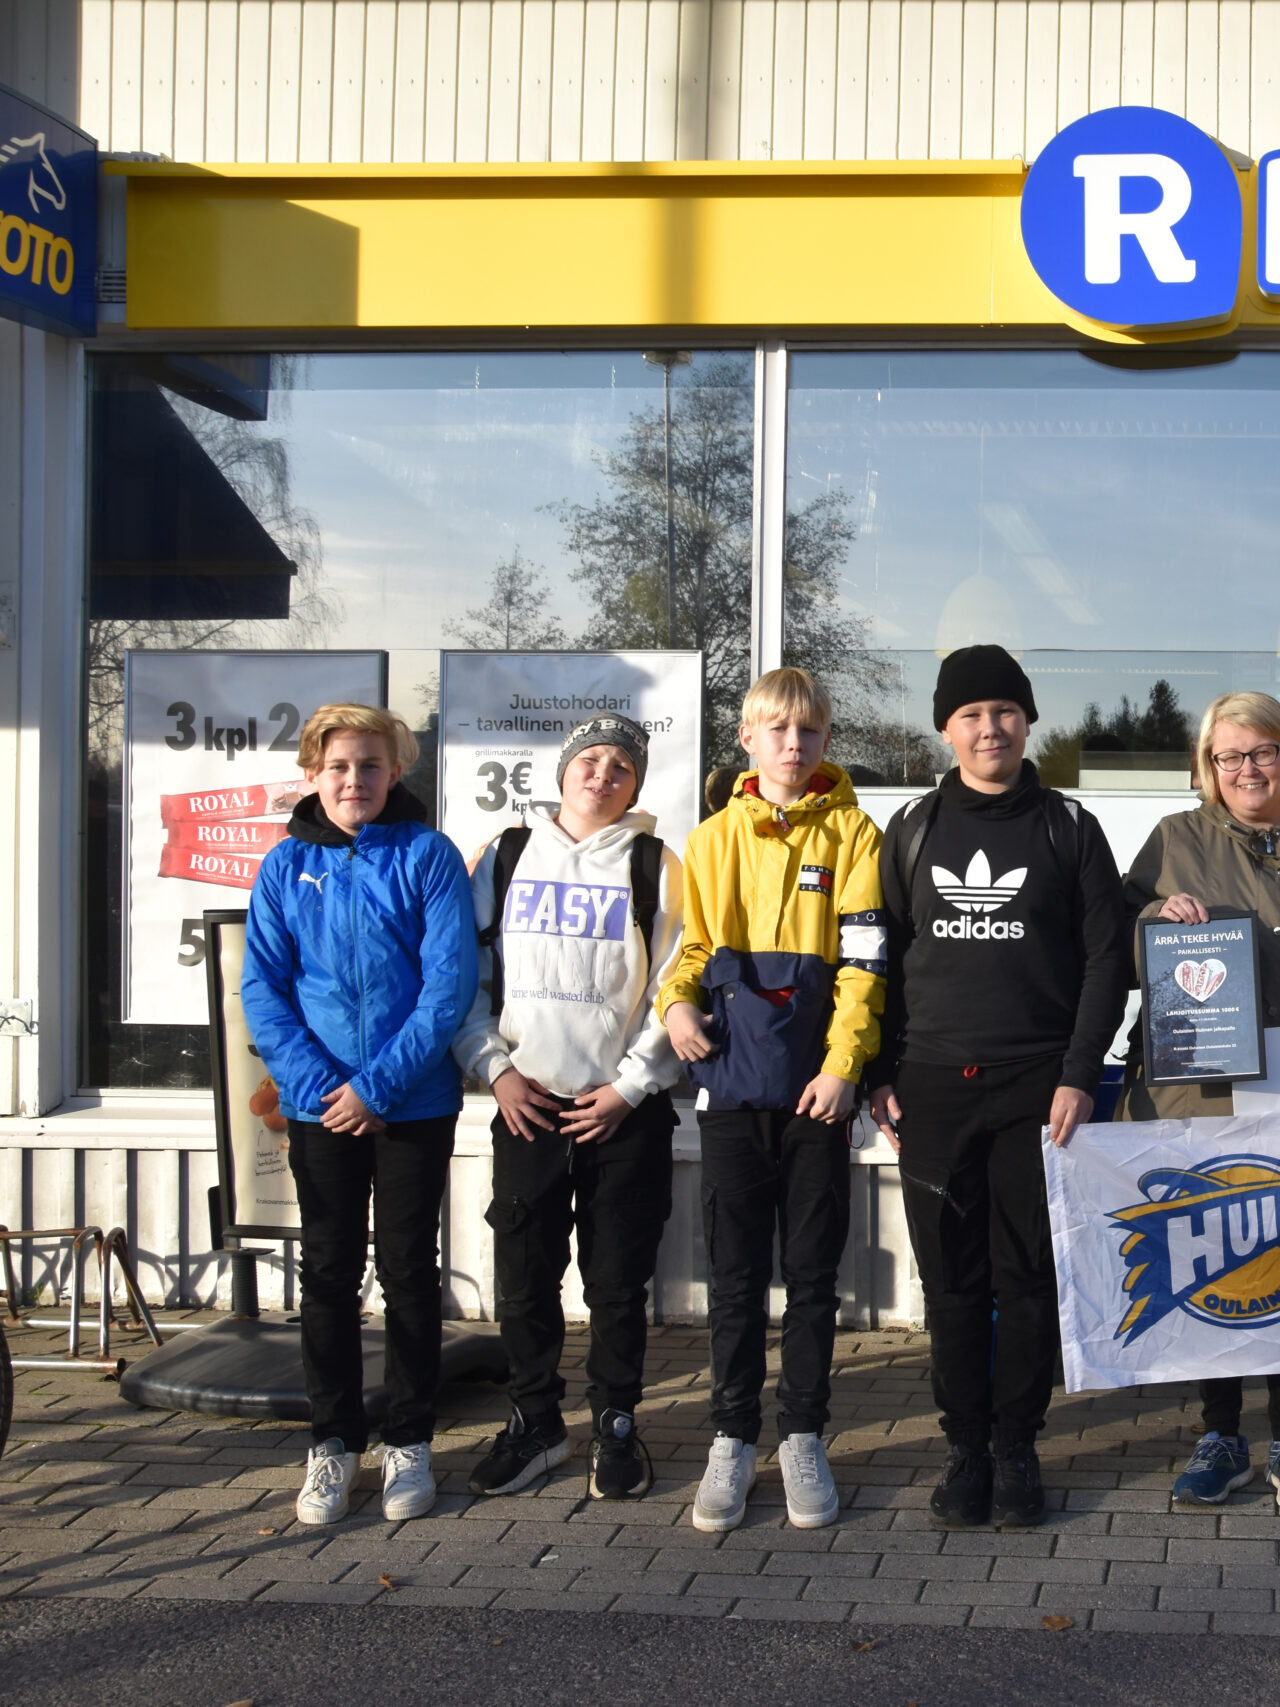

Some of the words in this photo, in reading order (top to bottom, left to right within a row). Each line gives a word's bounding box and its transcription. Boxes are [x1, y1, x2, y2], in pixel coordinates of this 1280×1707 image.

[1072, 153, 1197, 285] R
[0, 208, 75, 296] OTO
[509, 694, 632, 711] Juustohodari
[165, 701, 197, 751] 3
[204, 716, 258, 761] kpl
[477, 716, 564, 732] tavallinen
[475, 748, 534, 758] grillimakkaralla
[189, 790, 255, 813] ROYAL
[198, 825, 262, 843] ROYAL
[189, 853, 254, 879] ROYAL
[932, 915, 1025, 940] adidas
[1154, 934, 1180, 946] ÄRRÄ
[1181, 933, 1210, 944] TEKEE
[1211, 929, 1244, 942] HYVÄÄ
[1177, 946, 1222, 956] PAIKALLISESTI
[530, 987, 549, 1000] well
[550, 990, 583, 1003] wasted
[584, 994, 606, 1005] club
